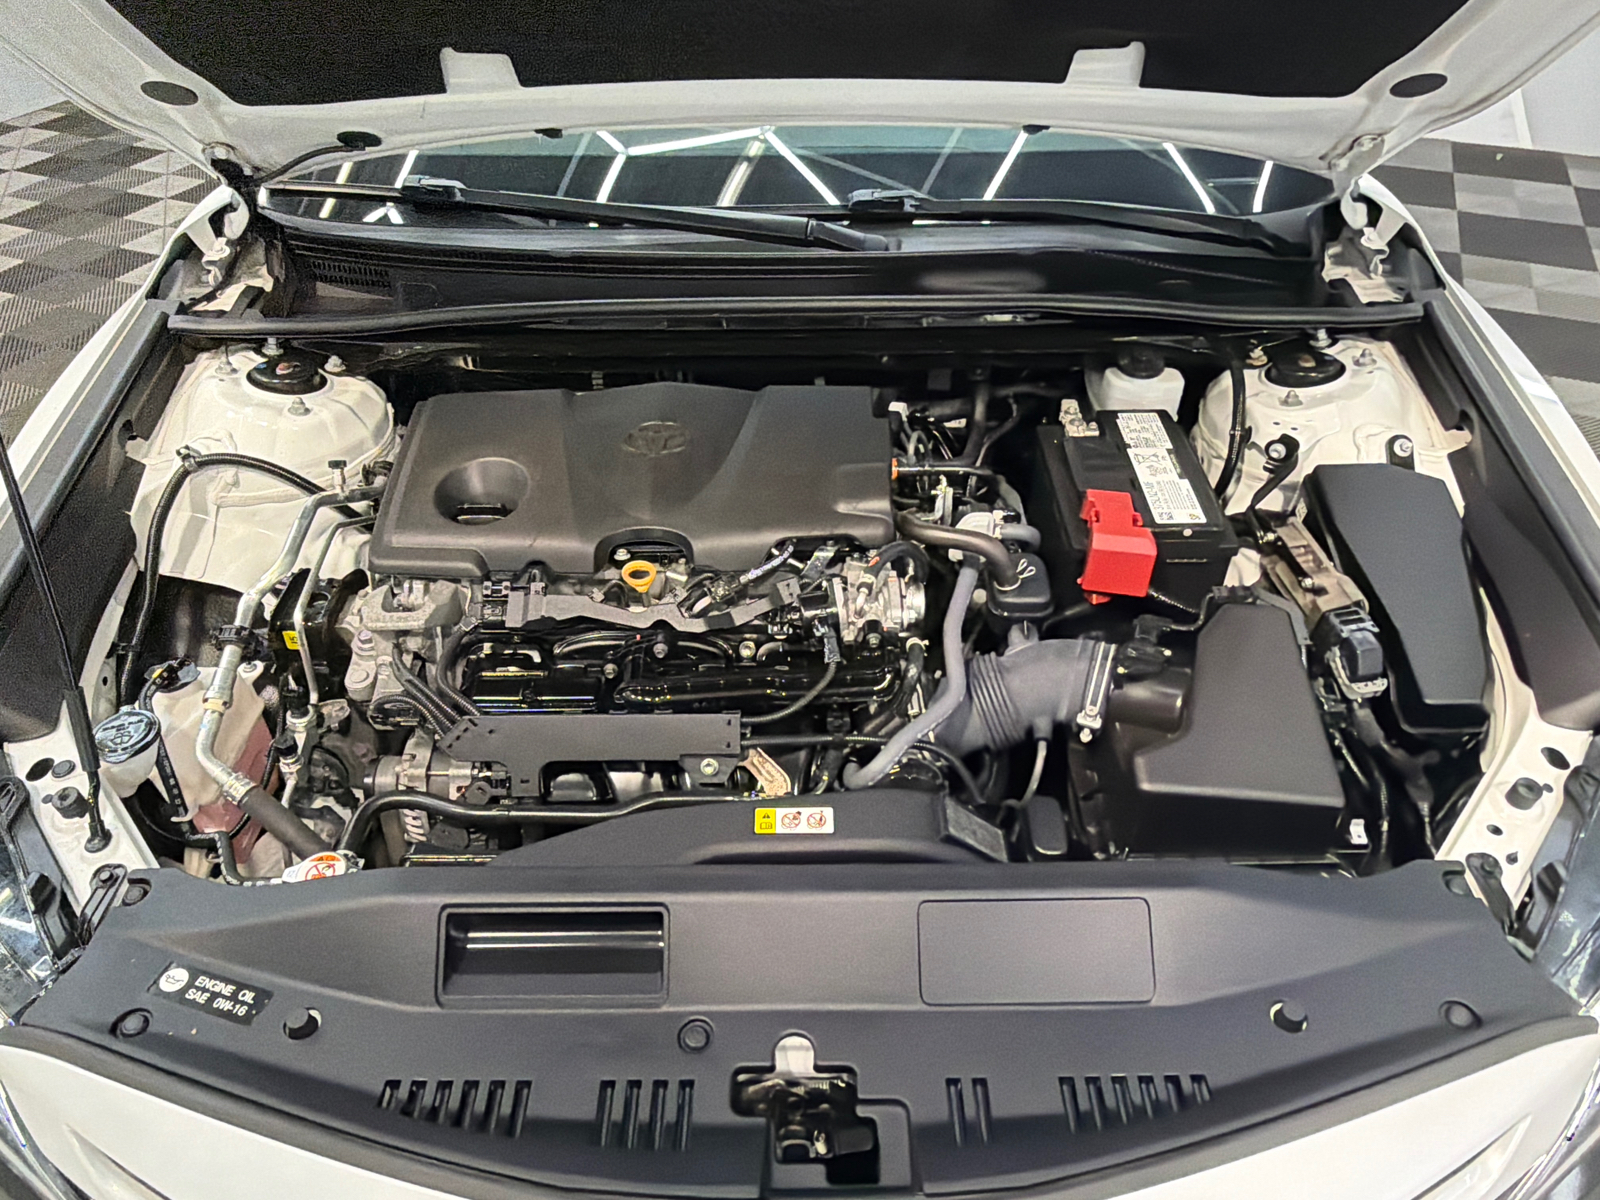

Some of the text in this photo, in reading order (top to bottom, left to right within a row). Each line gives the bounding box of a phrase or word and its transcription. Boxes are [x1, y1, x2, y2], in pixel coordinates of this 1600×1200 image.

[185, 988, 248, 1016] SAE 0W-16
[194, 976, 256, 1004] ENGINE OIL
